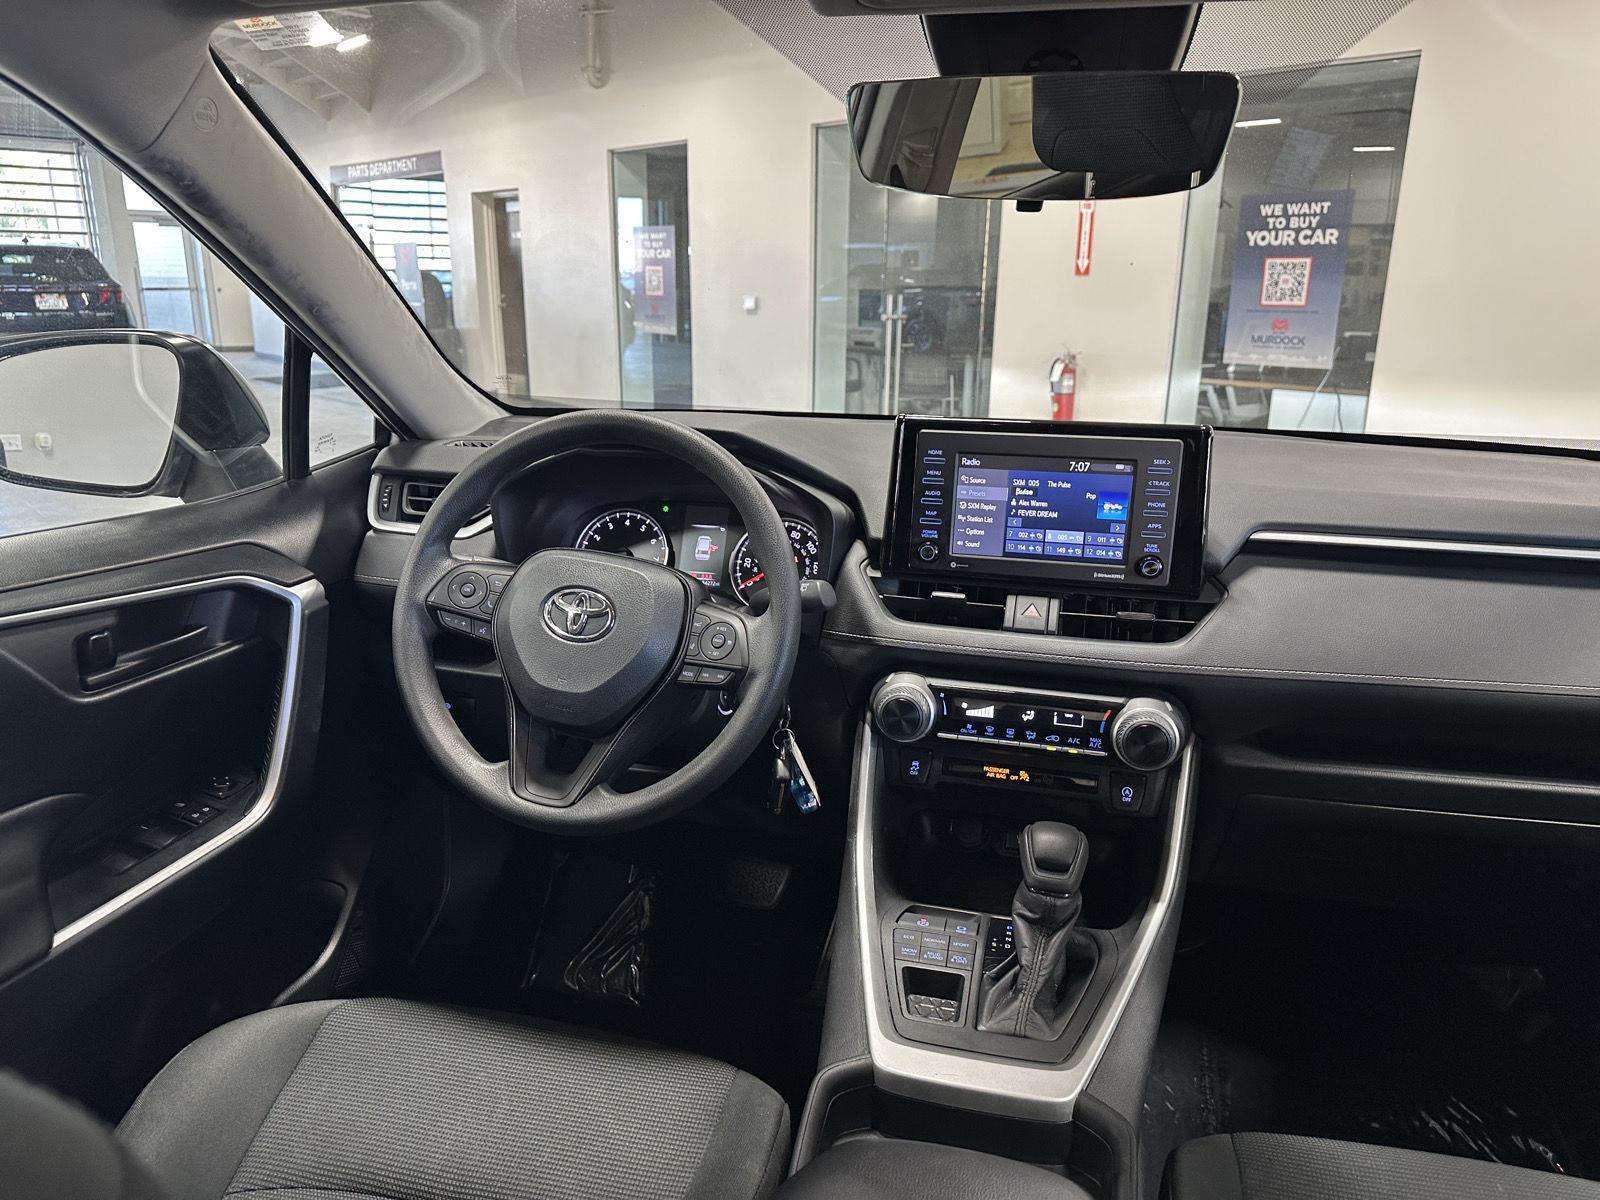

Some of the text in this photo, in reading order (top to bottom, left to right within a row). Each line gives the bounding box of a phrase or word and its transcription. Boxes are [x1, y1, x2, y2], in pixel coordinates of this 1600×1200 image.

[347, 157, 418, 178] PARTS DEPARTMENT
[1259, 201, 1331, 216] WE WANT
[1267, 215, 1320, 230] TO BUY
[1245, 228, 1340, 247] YOUR CAR
[656, 248, 672, 259] CAR
[1250, 334, 1306, 346] MURDOCK
[961, 457, 981, 466] Radio
[1069, 461, 1091, 472] 7:07
[969, 477, 986, 485] Source
[1012, 478, 1040, 487] SXM 005
[1047, 480, 1071, 489] The Pulse
[1085, 492, 1097, 501] Pop
[967, 502, 997, 512] SXM Replay
[1018, 499, 1048, 508] Alex Warren
[1017, 509, 1058, 518] FEVER DREAM
[966, 515, 993, 524] Station List
[607, 522, 614, 530] 3
[640, 524, 647, 532] 5
[790, 530, 801, 540] 80
[965, 528, 985, 536] Options
[805, 540, 817, 555] 100
[964, 540, 980, 548] Sound
[743, 557, 752, 568] 20
[1067, 737, 1081, 745] A/C
[983, 765, 1010, 775] PASSENGER
